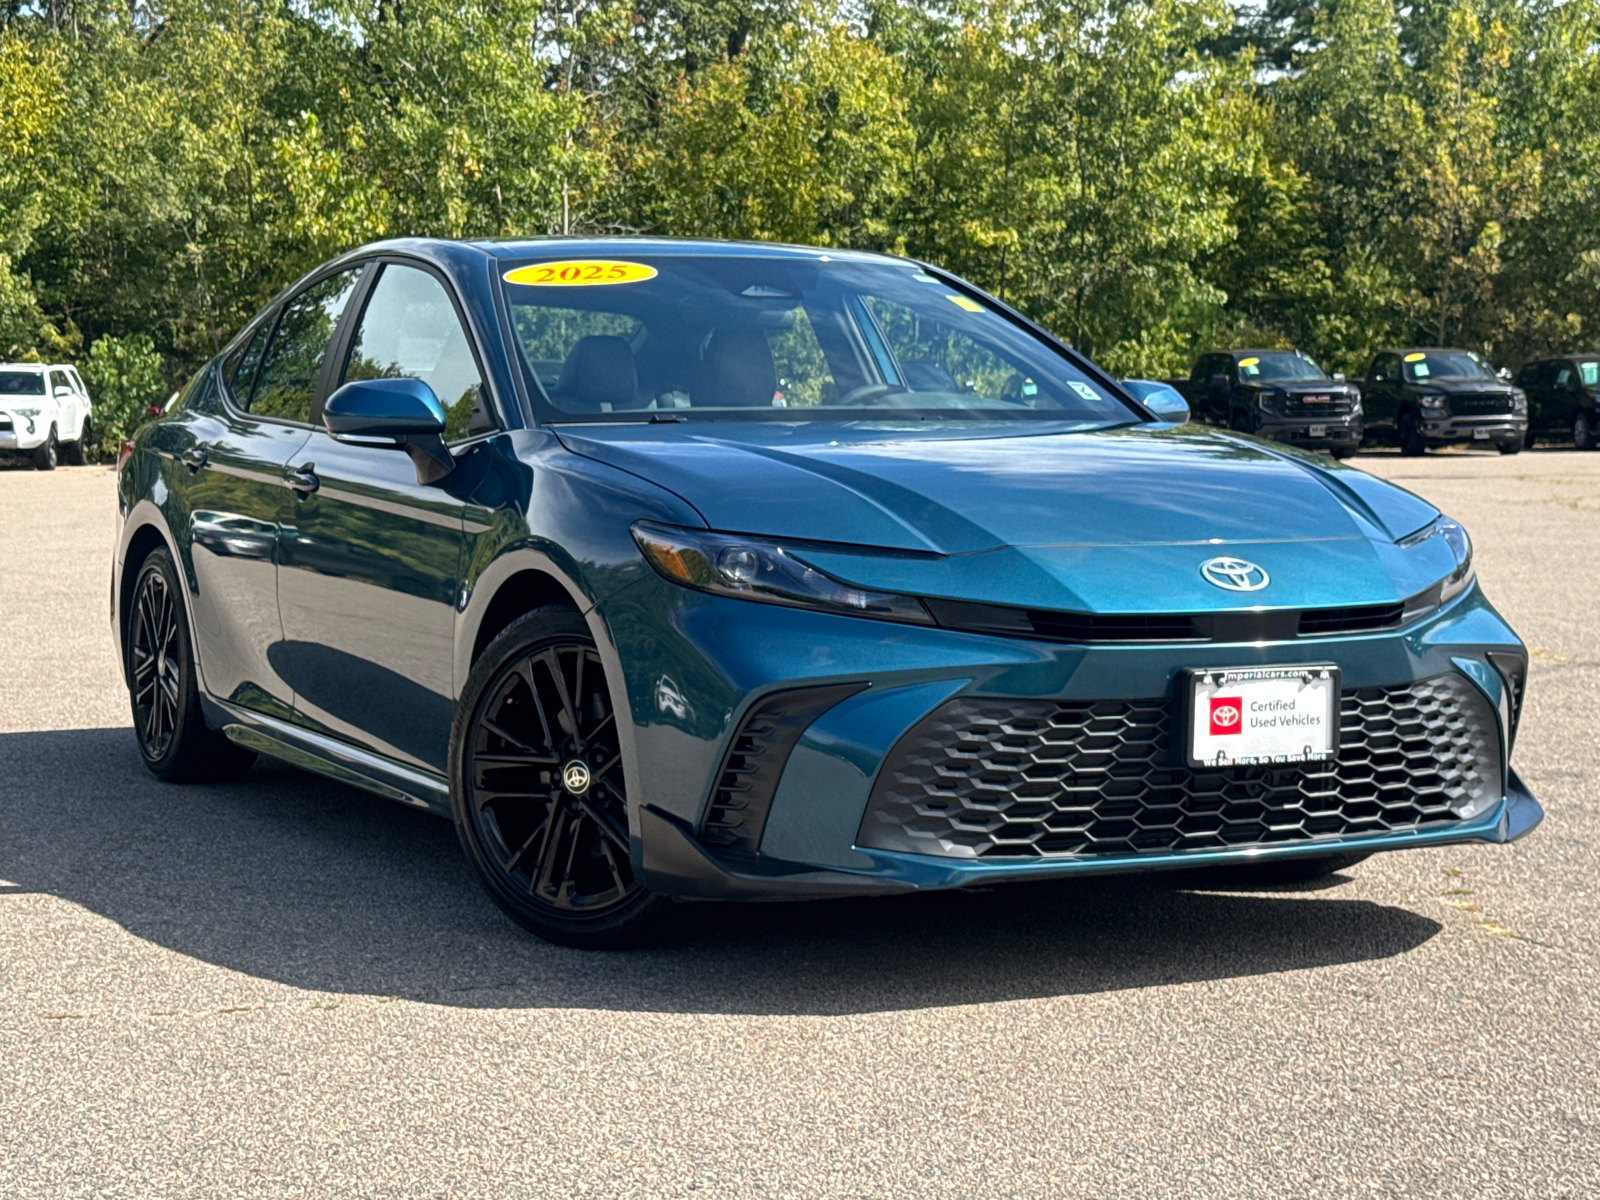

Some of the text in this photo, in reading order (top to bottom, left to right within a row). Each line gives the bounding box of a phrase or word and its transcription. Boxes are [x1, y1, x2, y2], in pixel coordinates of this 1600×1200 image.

[534, 264, 628, 283] 2025
[1302, 395, 1330, 404] GMC
[1250, 698, 1296, 712] Certified
[1250, 713, 1321, 728] Used Vehicles
[1306, 751, 1327, 761] More
